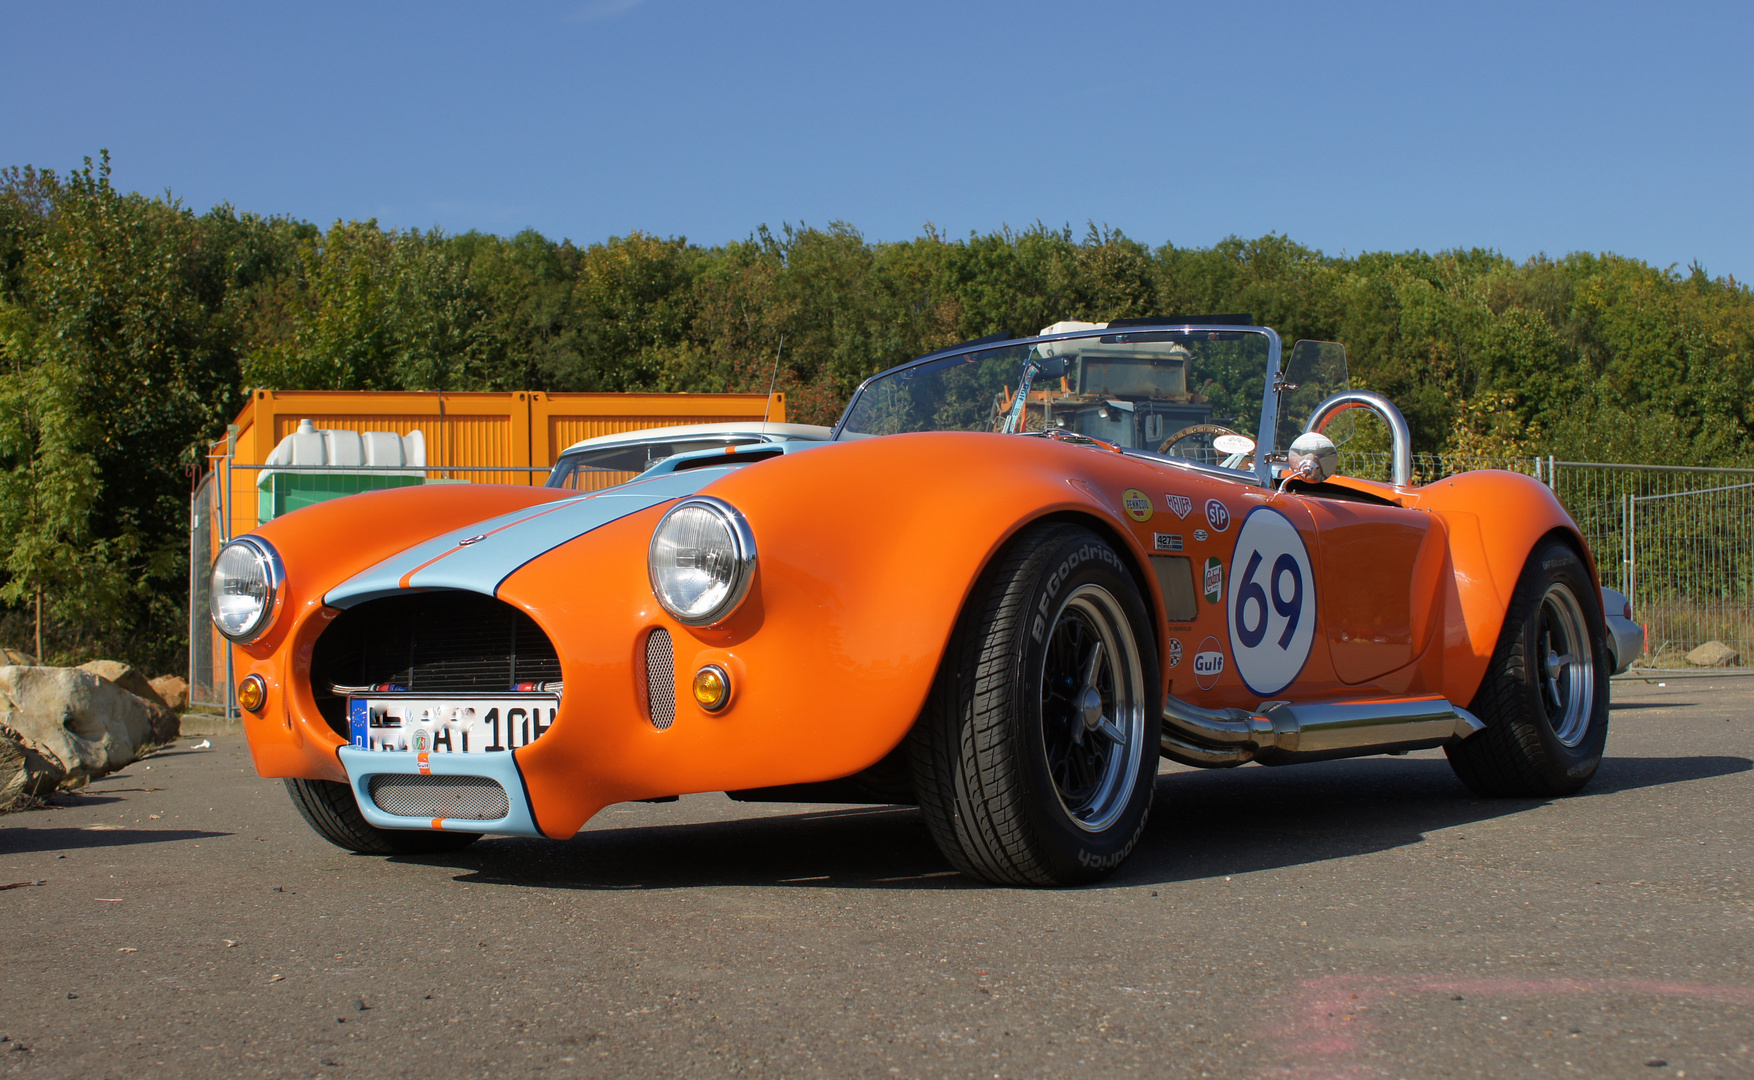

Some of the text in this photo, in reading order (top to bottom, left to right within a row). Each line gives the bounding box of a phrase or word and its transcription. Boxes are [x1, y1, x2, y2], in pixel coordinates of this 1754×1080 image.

[1167, 495, 1191, 518] HEUER
[1208, 503, 1226, 525] STP
[1157, 535, 1172, 545] 427
[1206, 566, 1221, 593] Castrol
[1235, 549, 1303, 651] 69
[1195, 655, 1223, 671] Gulf
